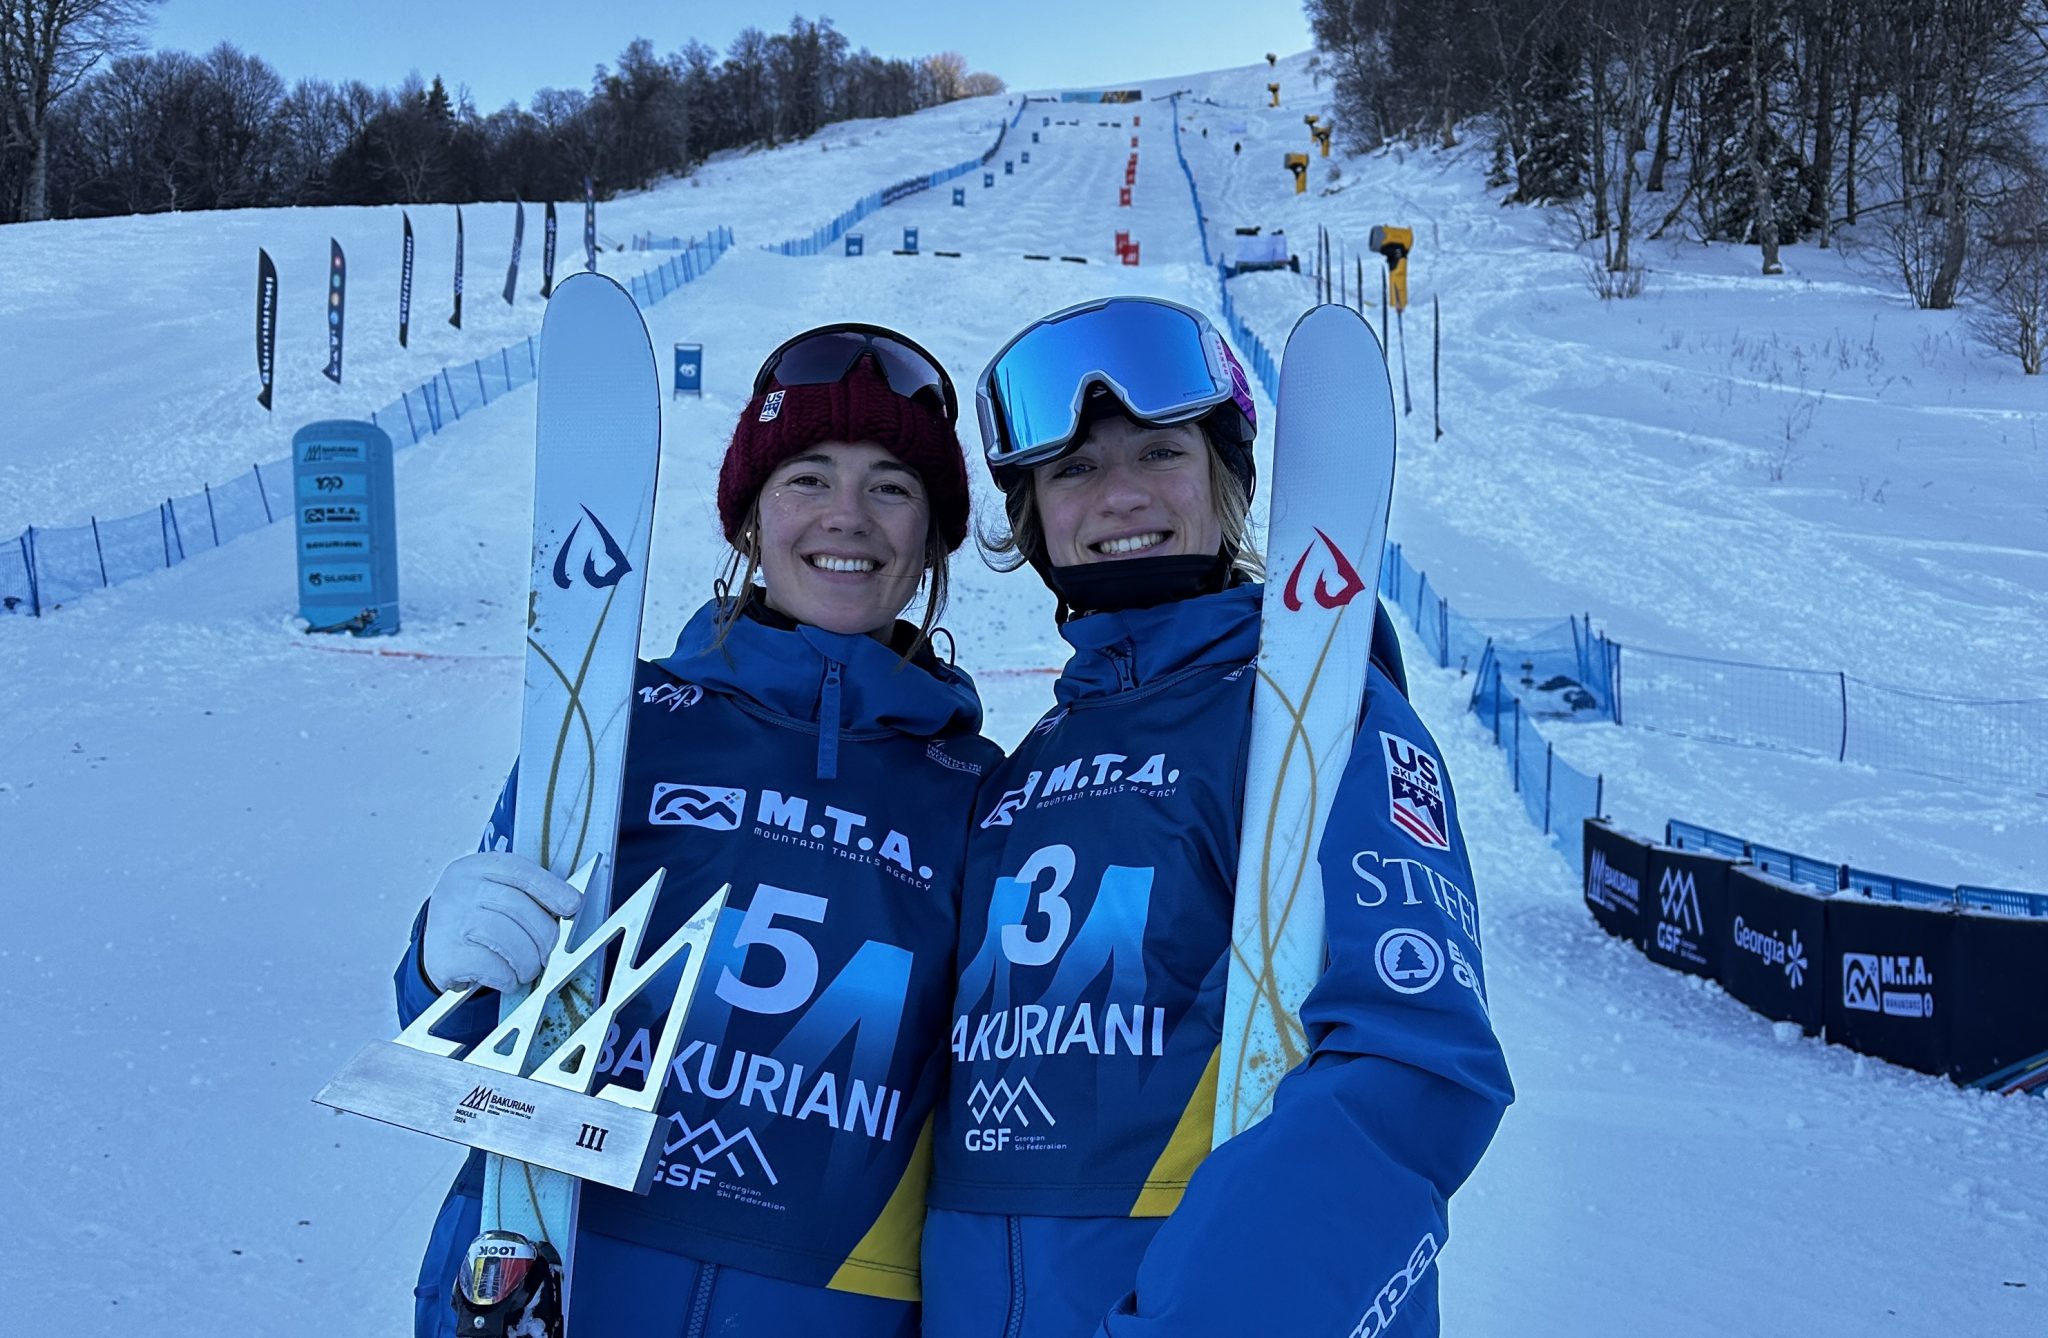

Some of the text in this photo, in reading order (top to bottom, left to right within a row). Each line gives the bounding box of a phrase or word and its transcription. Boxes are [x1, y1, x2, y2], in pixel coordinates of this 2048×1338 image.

[766, 391, 784, 404] US
[1041, 753, 1180, 798] M.T.A.
[1386, 737, 1439, 787] US
[1036, 784, 1177, 809] MOUNTAIN TRAILS AGENCY
[1393, 766, 1441, 799] SKI TEAM
[757, 789, 933, 880] M.T.A.
[753, 827, 932, 892] MOUNTAIN TRAILS AGENCY
[1001, 844, 1076, 966] 3
[715, 883, 829, 1015] 5
[1657, 920, 1683, 954] GSF
[1734, 915, 1786, 966] Georgia
[1881, 955, 1933, 986] M.T.A.
[490, 1094, 536, 1115] BAKURIANI
[575, 1123, 609, 1152] III
[965, 1128, 1046, 1152] GSF Georgian
[1014, 1142, 1067, 1151] Ski Federation
[716, 1189, 786, 1212] Ski Federation
[718, 1181, 762, 1197] Georgian
[479, 1246, 516, 1257] LOOK
